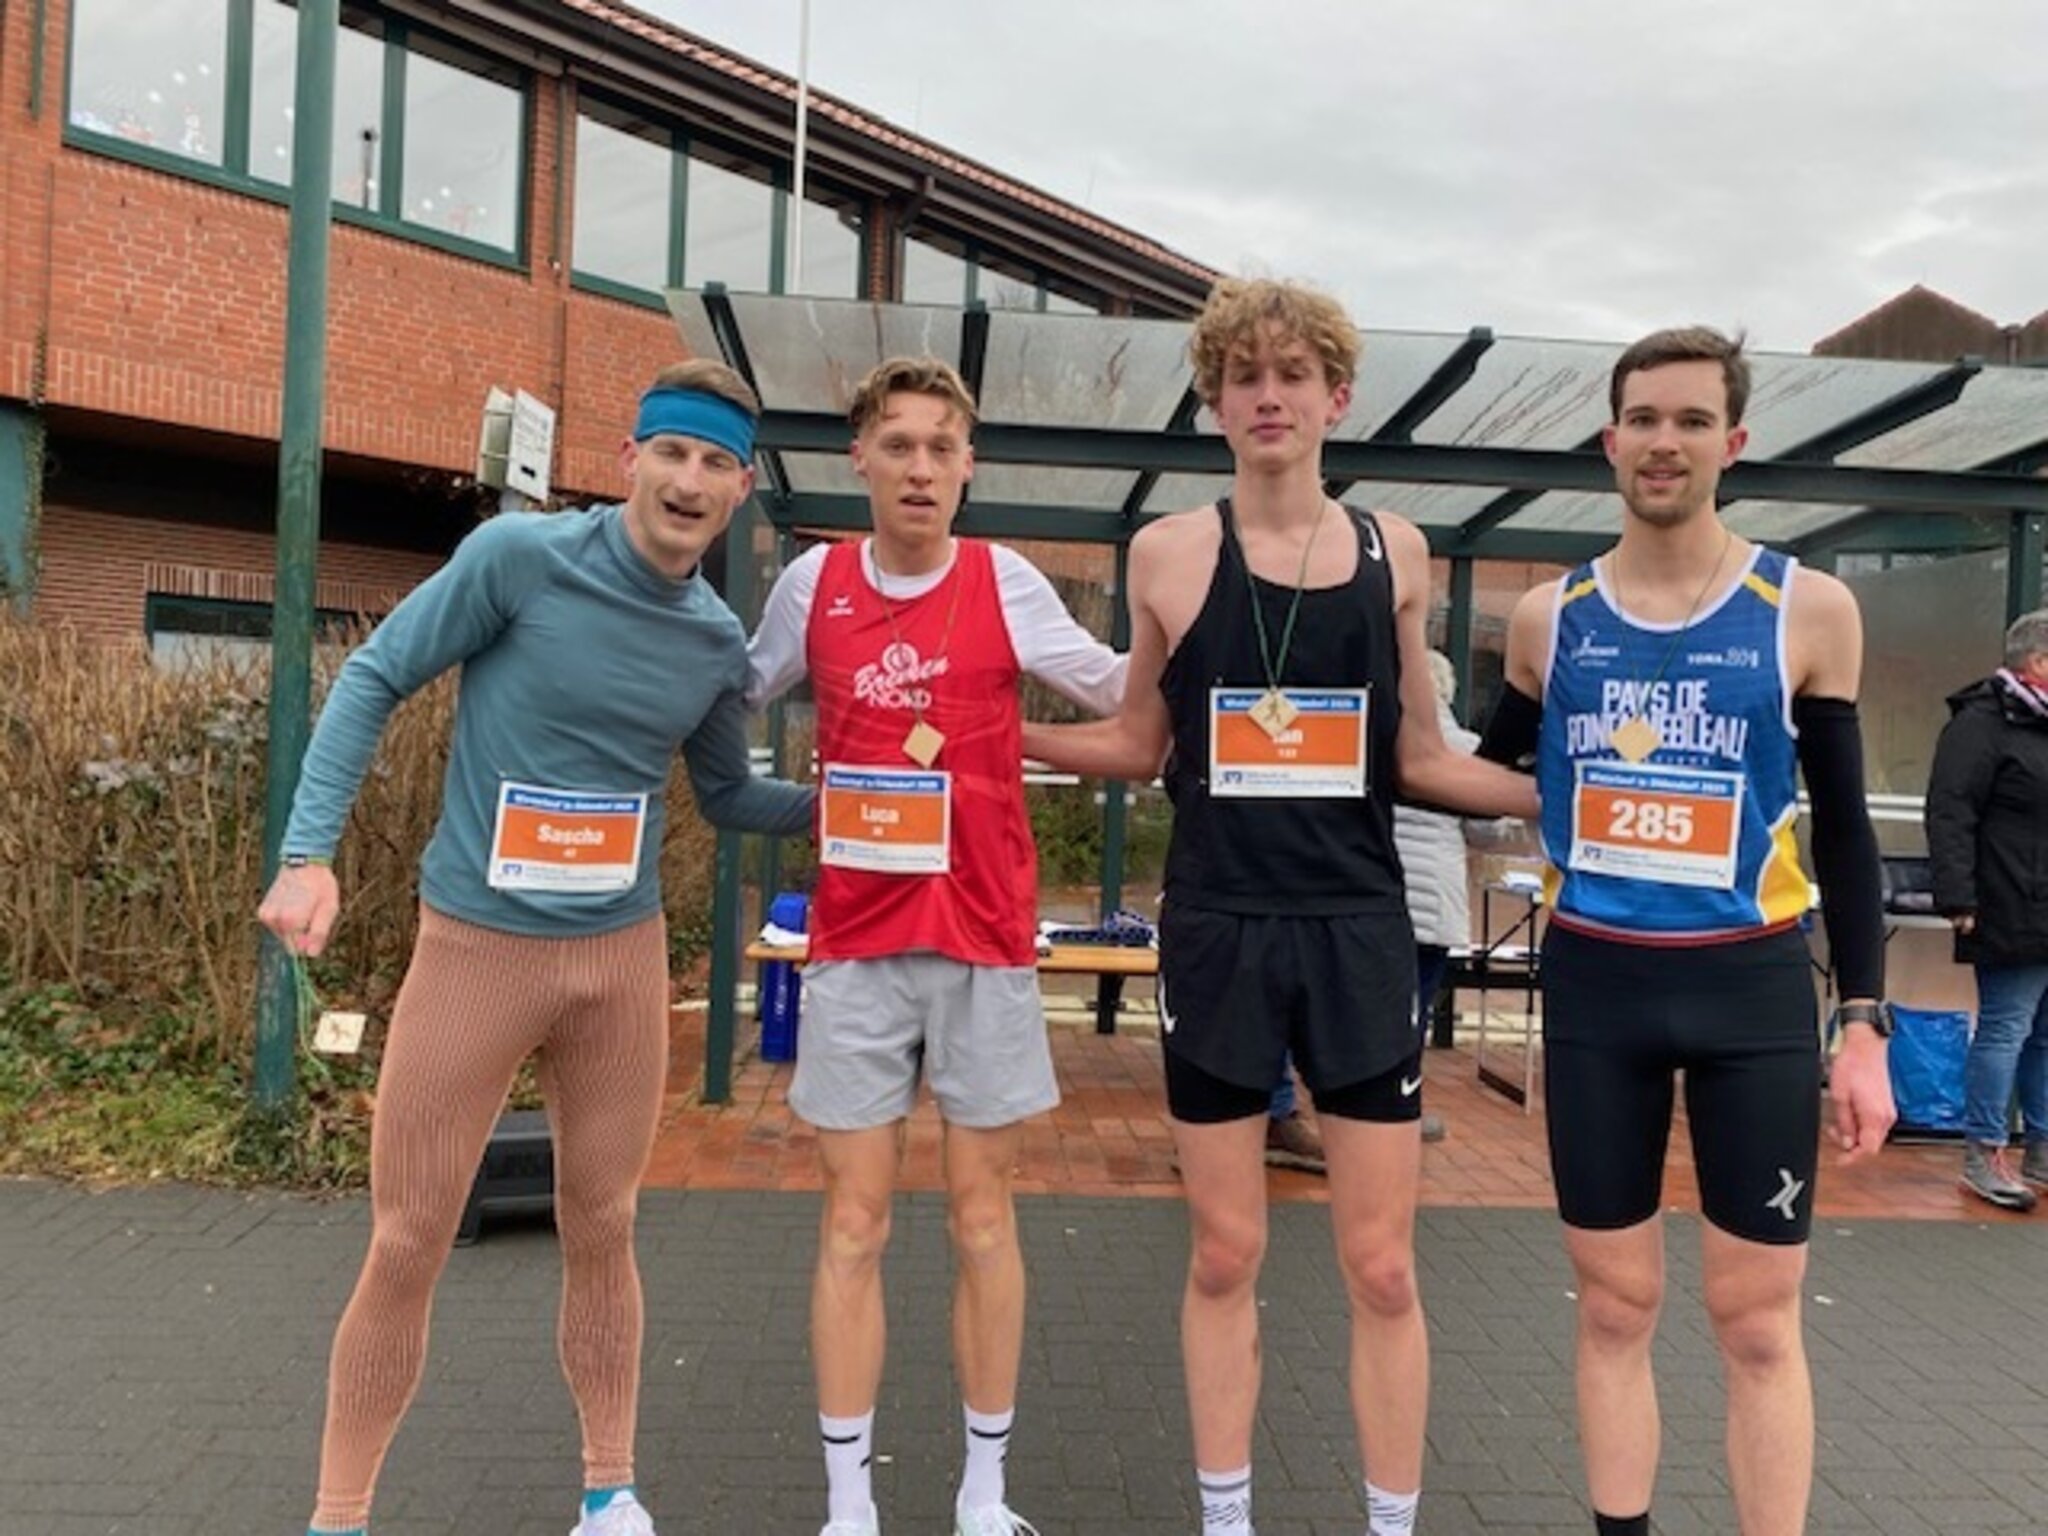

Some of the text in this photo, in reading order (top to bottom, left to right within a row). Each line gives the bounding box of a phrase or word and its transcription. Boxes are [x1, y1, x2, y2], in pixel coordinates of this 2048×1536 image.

[869, 688, 933, 709] NORD
[1602, 679, 1709, 715] PAYS DE
[861, 803, 900, 824] Luca
[1609, 798, 1694, 845] 285
[537, 823, 606, 846] Sascha
